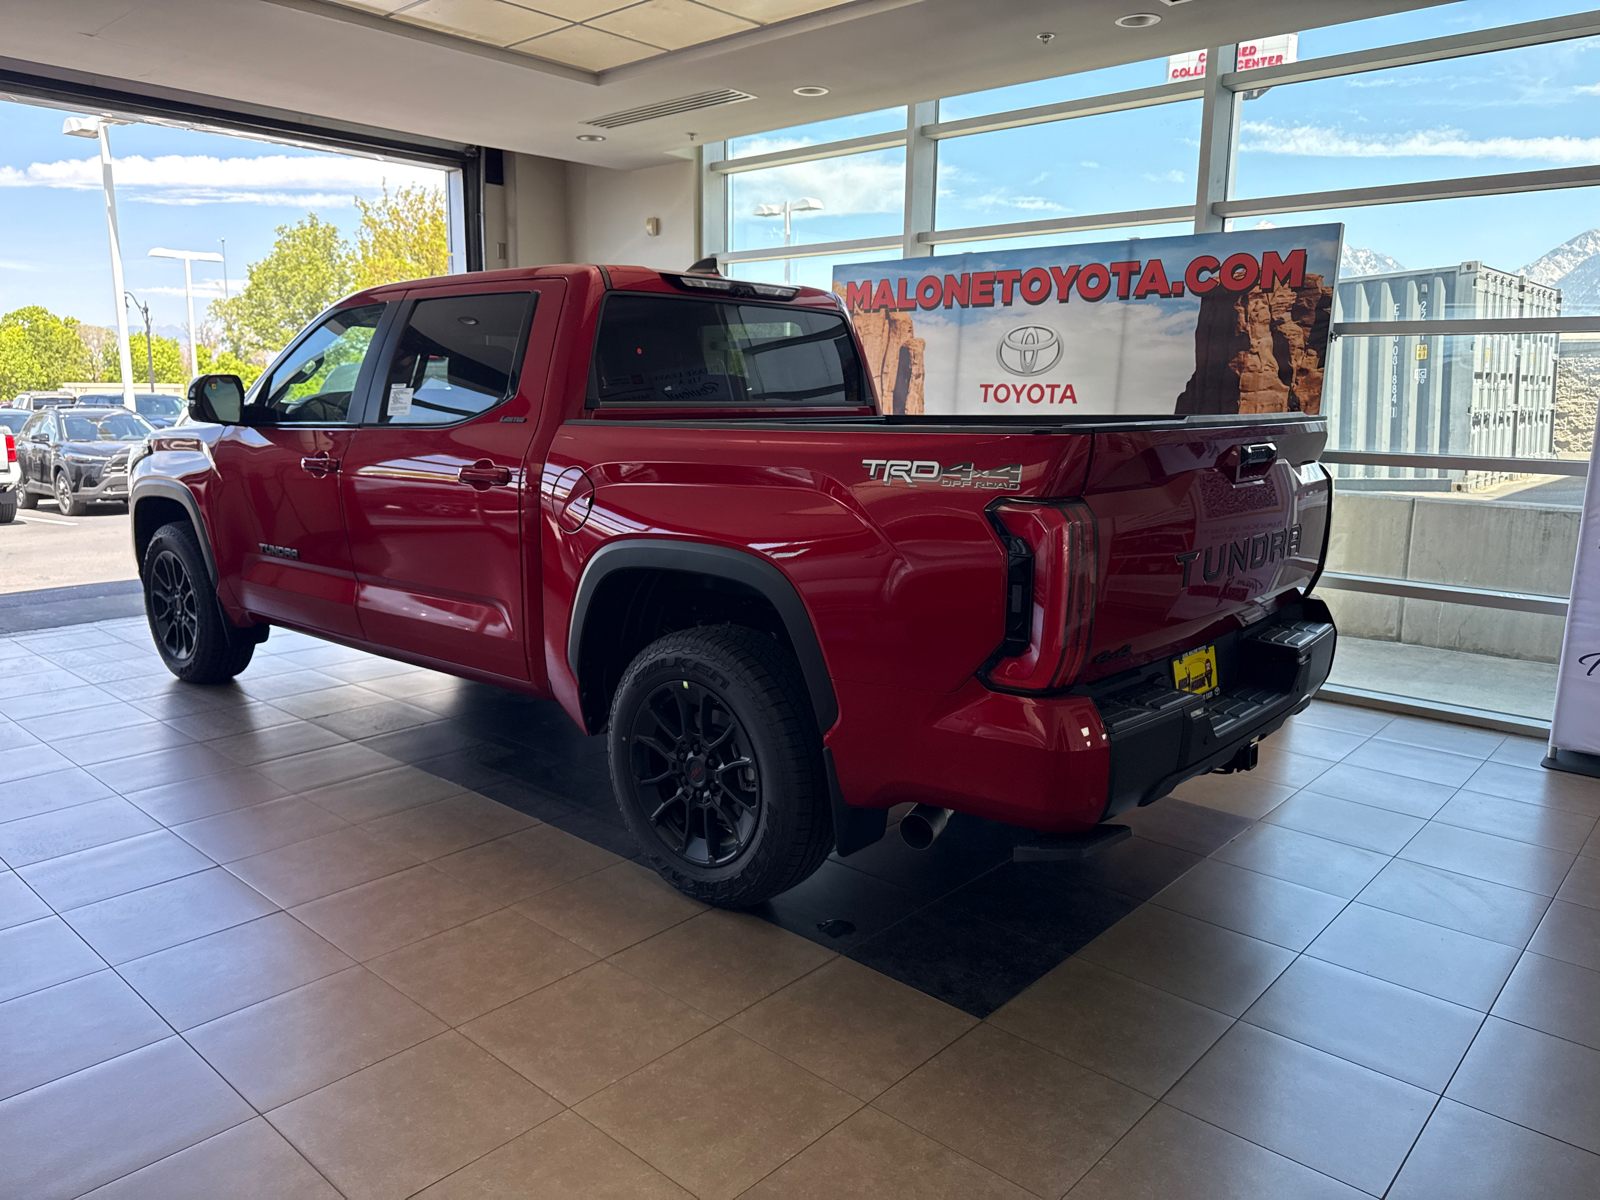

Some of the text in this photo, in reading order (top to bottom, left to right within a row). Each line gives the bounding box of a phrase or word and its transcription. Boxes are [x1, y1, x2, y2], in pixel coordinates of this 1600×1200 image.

[1172, 54, 1283, 79] COLLI CENTER
[846, 249, 1307, 313] MALONETOYOTA.COM
[979, 383, 1078, 404] TOYOTA
[862, 459, 943, 487] TRD
[941, 479, 1021, 490] OFF ROAD
[258, 542, 299, 559] TUNDRA
[1174, 523, 1302, 591] TUNDRA
